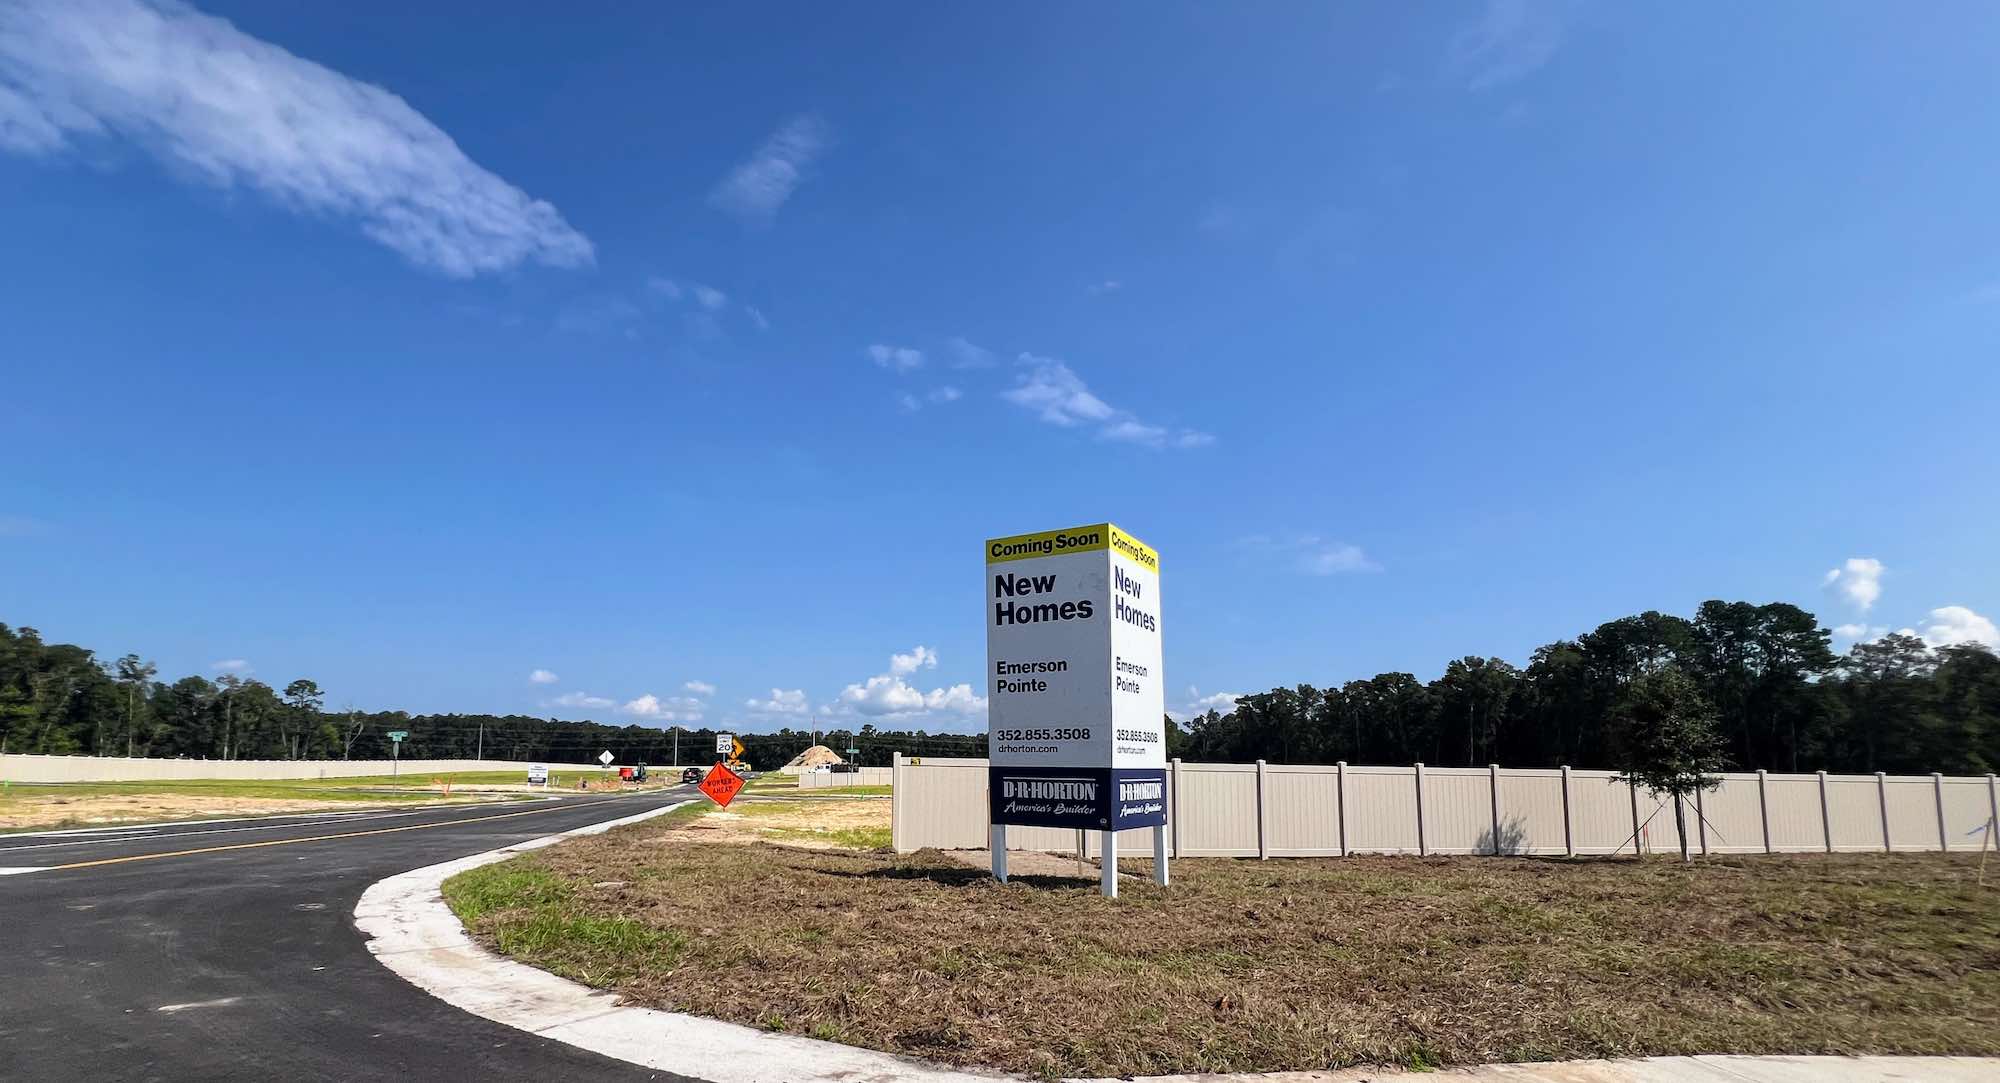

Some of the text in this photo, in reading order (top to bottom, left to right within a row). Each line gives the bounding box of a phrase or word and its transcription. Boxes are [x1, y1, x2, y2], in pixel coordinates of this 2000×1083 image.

[991, 532, 1099, 557] Coming Soon
[1111, 531, 1156, 568] Coming Soon
[995, 573, 1056, 598] New
[1114, 565, 1141, 599] New
[995, 600, 1093, 625] Homes
[1115, 595, 1155, 632] Homes
[996, 660, 1067, 675] Emerson
[1116, 656, 1148, 678] Emerson
[997, 679, 1047, 693] Pointe
[1116, 676, 1140, 694] Pointe
[997, 728, 1091, 741] 352.855.3508
[1116, 729, 1158, 743] 352.855.3508
[718, 743, 731, 751] 20
[998, 744, 1058, 753] drhorton.com
[1004, 801, 1096, 815] America's Builder
[1119, 803, 1144, 818] America's
